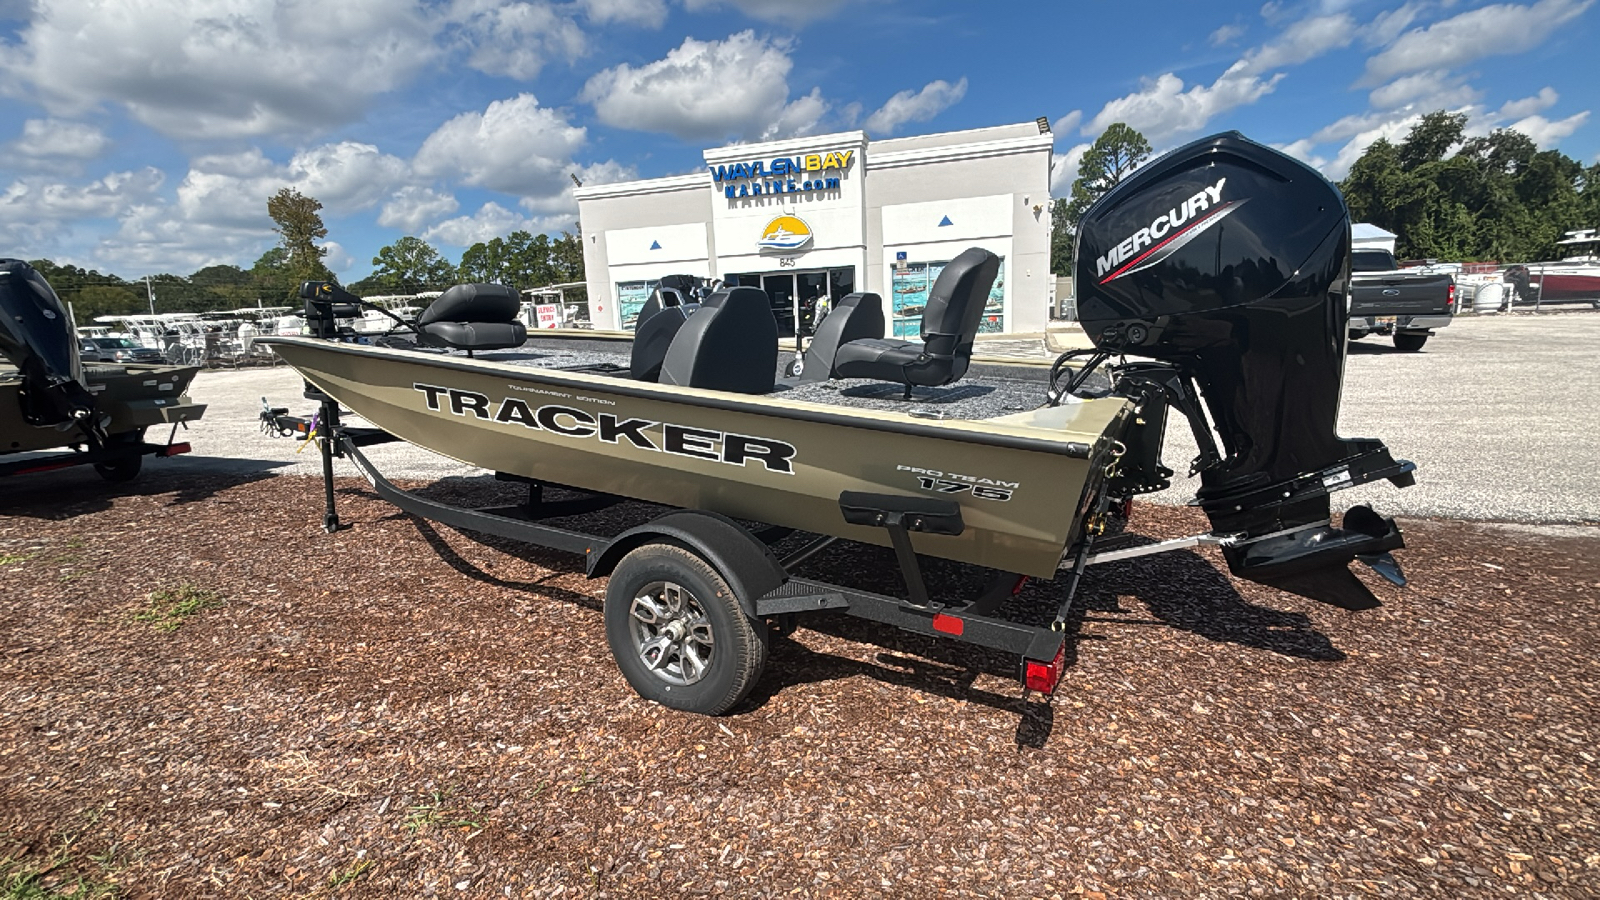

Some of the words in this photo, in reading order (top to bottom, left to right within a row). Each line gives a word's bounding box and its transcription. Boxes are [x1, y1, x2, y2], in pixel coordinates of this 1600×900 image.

[709, 156, 801, 183] WAYLEN
[805, 150, 854, 171] BAY
[725, 178, 840, 199] MARINE.com
[1097, 177, 1226, 277] MERCURY
[780, 258, 796, 267] 845
[508, 384, 572, 399] TOURNAMENT
[576, 395, 616, 406] EDITION
[413, 382, 798, 475] TRACKER
[896, 464, 943, 478] PRO
[947, 472, 1020, 489] TEAM
[917, 476, 1013, 502] 175
